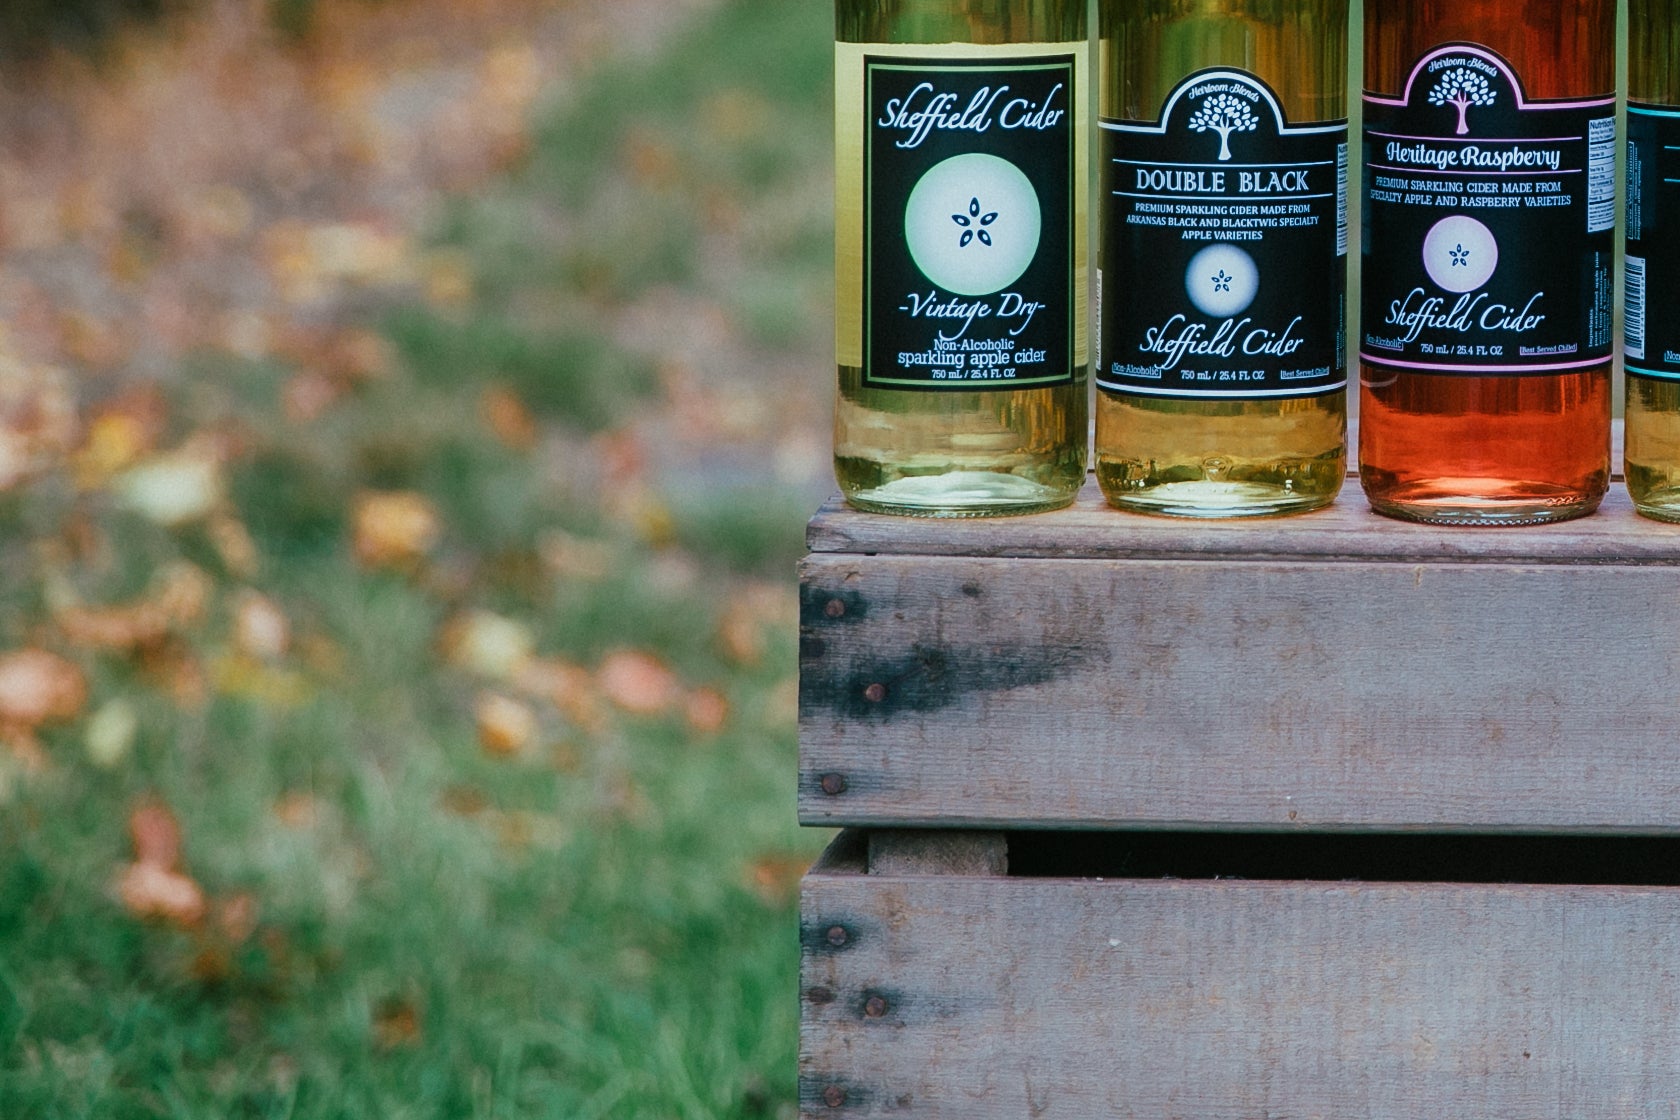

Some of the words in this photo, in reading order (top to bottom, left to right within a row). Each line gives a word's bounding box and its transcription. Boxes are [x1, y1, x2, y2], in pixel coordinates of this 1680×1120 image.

[1428, 57, 1466, 73] Heirloom
[1467, 58, 1498, 77] Blends
[1188, 83, 1228, 100] Heirloom
[1230, 84, 1260, 102] Blends
[878, 82, 1009, 148] Sheffield
[999, 82, 1064, 130] Cider
[1386, 141, 1459, 170] Heritage
[1460, 146, 1561, 172] Raspberry
[1136, 169, 1225, 192] DOUBLE
[1239, 171, 1309, 192] BLACK
[1376, 176, 1408, 189] PREMIUM
[1411, 180, 1463, 192] SPARKLING
[1467, 183, 1498, 193] CIDER
[1502, 183, 1532, 193] MADE
[1536, 182, 1561, 192] FROM
[1370, 189, 1402, 203] SPECIALTY
[1405, 194, 1432, 205] APPLE
[1435, 196, 1457, 206] AND
[1461, 197, 1521, 207] RASPBERRY
[1524, 195, 1571, 206] VARIETIES
[1135, 202, 1173, 213] PREMIUM
[1175, 205, 1227, 215] SPARKLING
[1230, 206, 1258, 215] CIDER
[1260, 205, 1286, 214] MADE
[1288, 204, 1310, 213] FROM
[1126, 215, 1166, 225] ARKANSAS
[1168, 217, 1197, 227] BLACK
[1199, 218, 1220, 227] AND
[1222, 218, 1277, 227] BLACKTWIG
[1280, 216, 1319, 226] SPECIALTY
[1182, 231, 1212, 239] APPLE
[1214, 231, 1263, 240] VARIETIES
[1385, 287, 1488, 342] Sheffield
[1479, 291, 1546, 332] Cider
[933, 338, 1014, 351] Non-Alcoholic
[1139, 314, 1251, 370] Sheffield
[1242, 316, 1304, 356] Cider
[1421, 343, 1433, 354] 750
[1436, 344, 1449, 354] mL
[1457, 345, 1473, 355] 25.4
[1476, 345, 1488, 355] FL
[1490, 345, 1503, 355] OZ
[898, 351, 964, 368] sparkling
[970, 351, 1010, 368] apple
[1014, 349, 1046, 364] cider
[932, 369, 946, 379] 750
[949, 369, 962, 378] mL
[971, 369, 988, 378] 25.4
[991, 368, 1001, 378] FL
[1004, 368, 1016, 378] OZ
[1181, 369, 1195, 380] 750
[1197, 369, 1211, 380] mL
[1220, 369, 1236, 380] 25.4
[1239, 369, 1249, 380] FL
[1252, 369, 1265, 380] OZ
